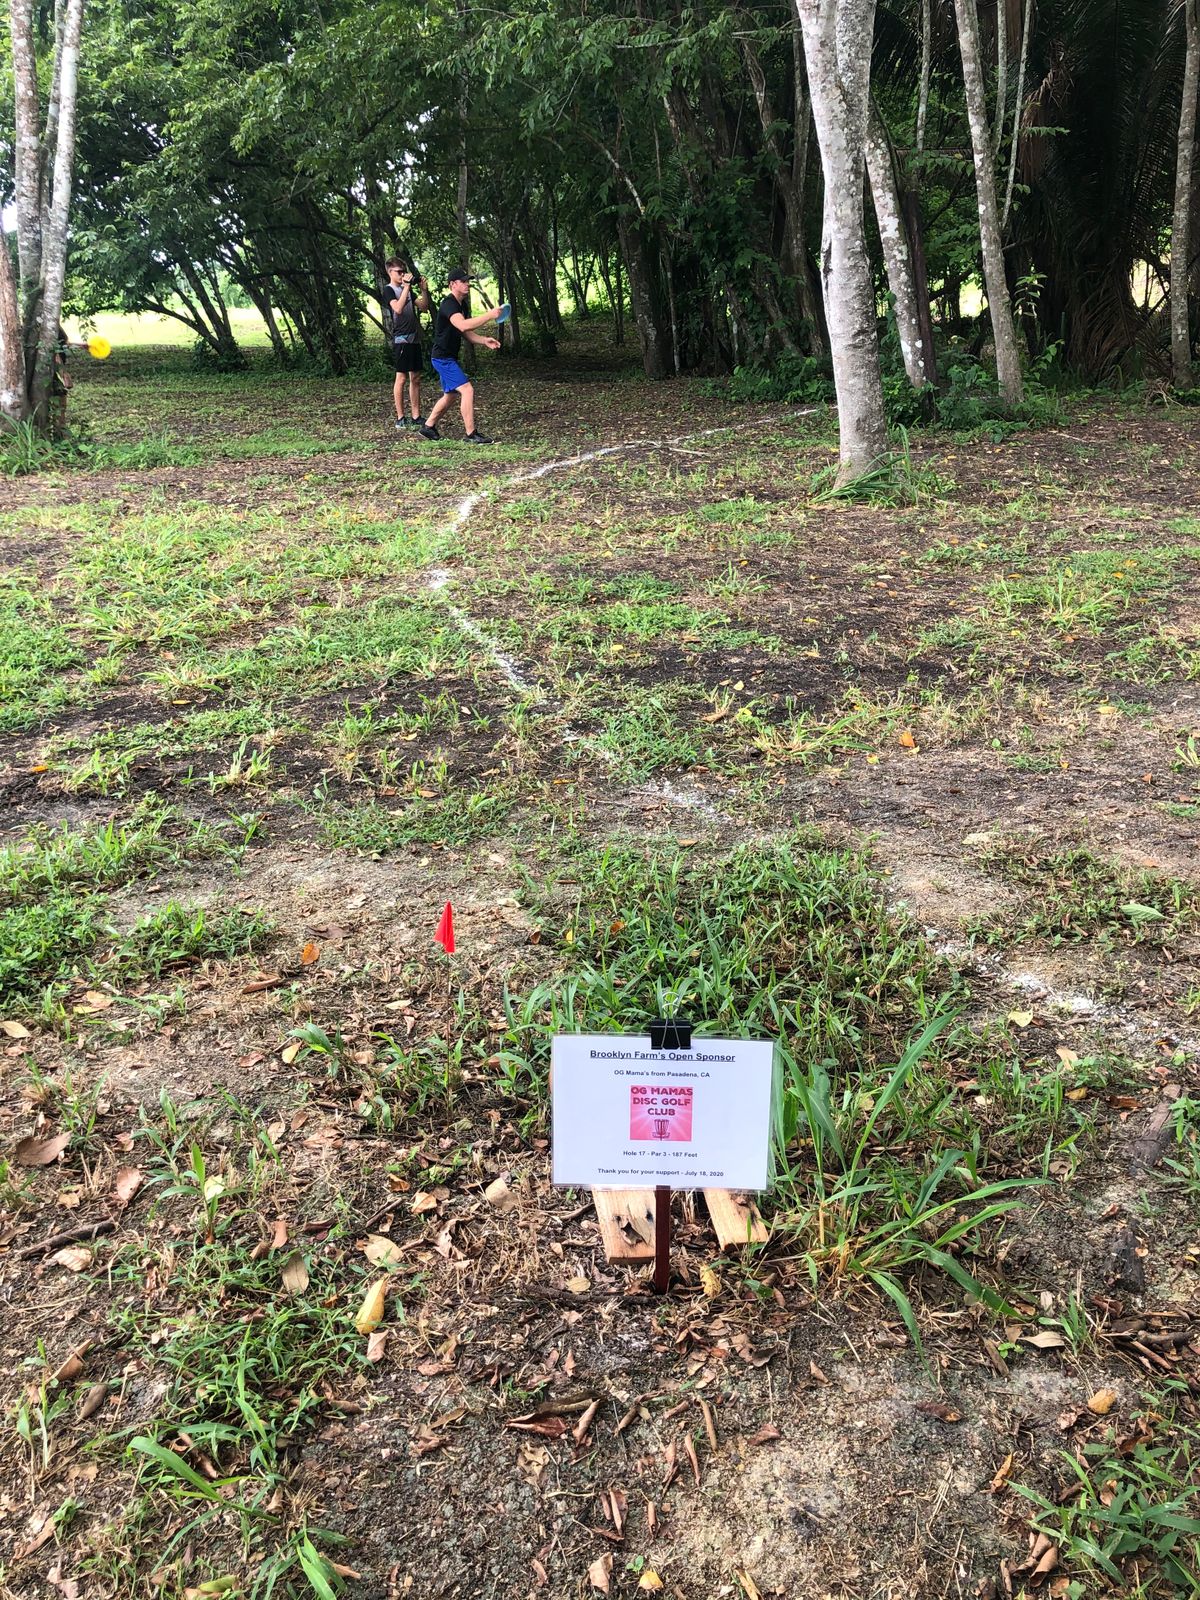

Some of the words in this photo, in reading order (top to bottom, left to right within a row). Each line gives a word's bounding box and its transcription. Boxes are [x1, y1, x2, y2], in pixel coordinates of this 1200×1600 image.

[590, 1050, 632, 1060] Brooklyn
[634, 1051, 666, 1060] Farm's
[668, 1052, 694, 1061] Open
[696, 1053, 736, 1062] Sponsor
[631, 1086, 647, 1095] OG
[651, 1087, 693, 1096] MAMAS
[633, 1097, 657, 1105] DISC
[662, 1098, 691, 1106] GOLF
[647, 1108, 675, 1116] CLUB
